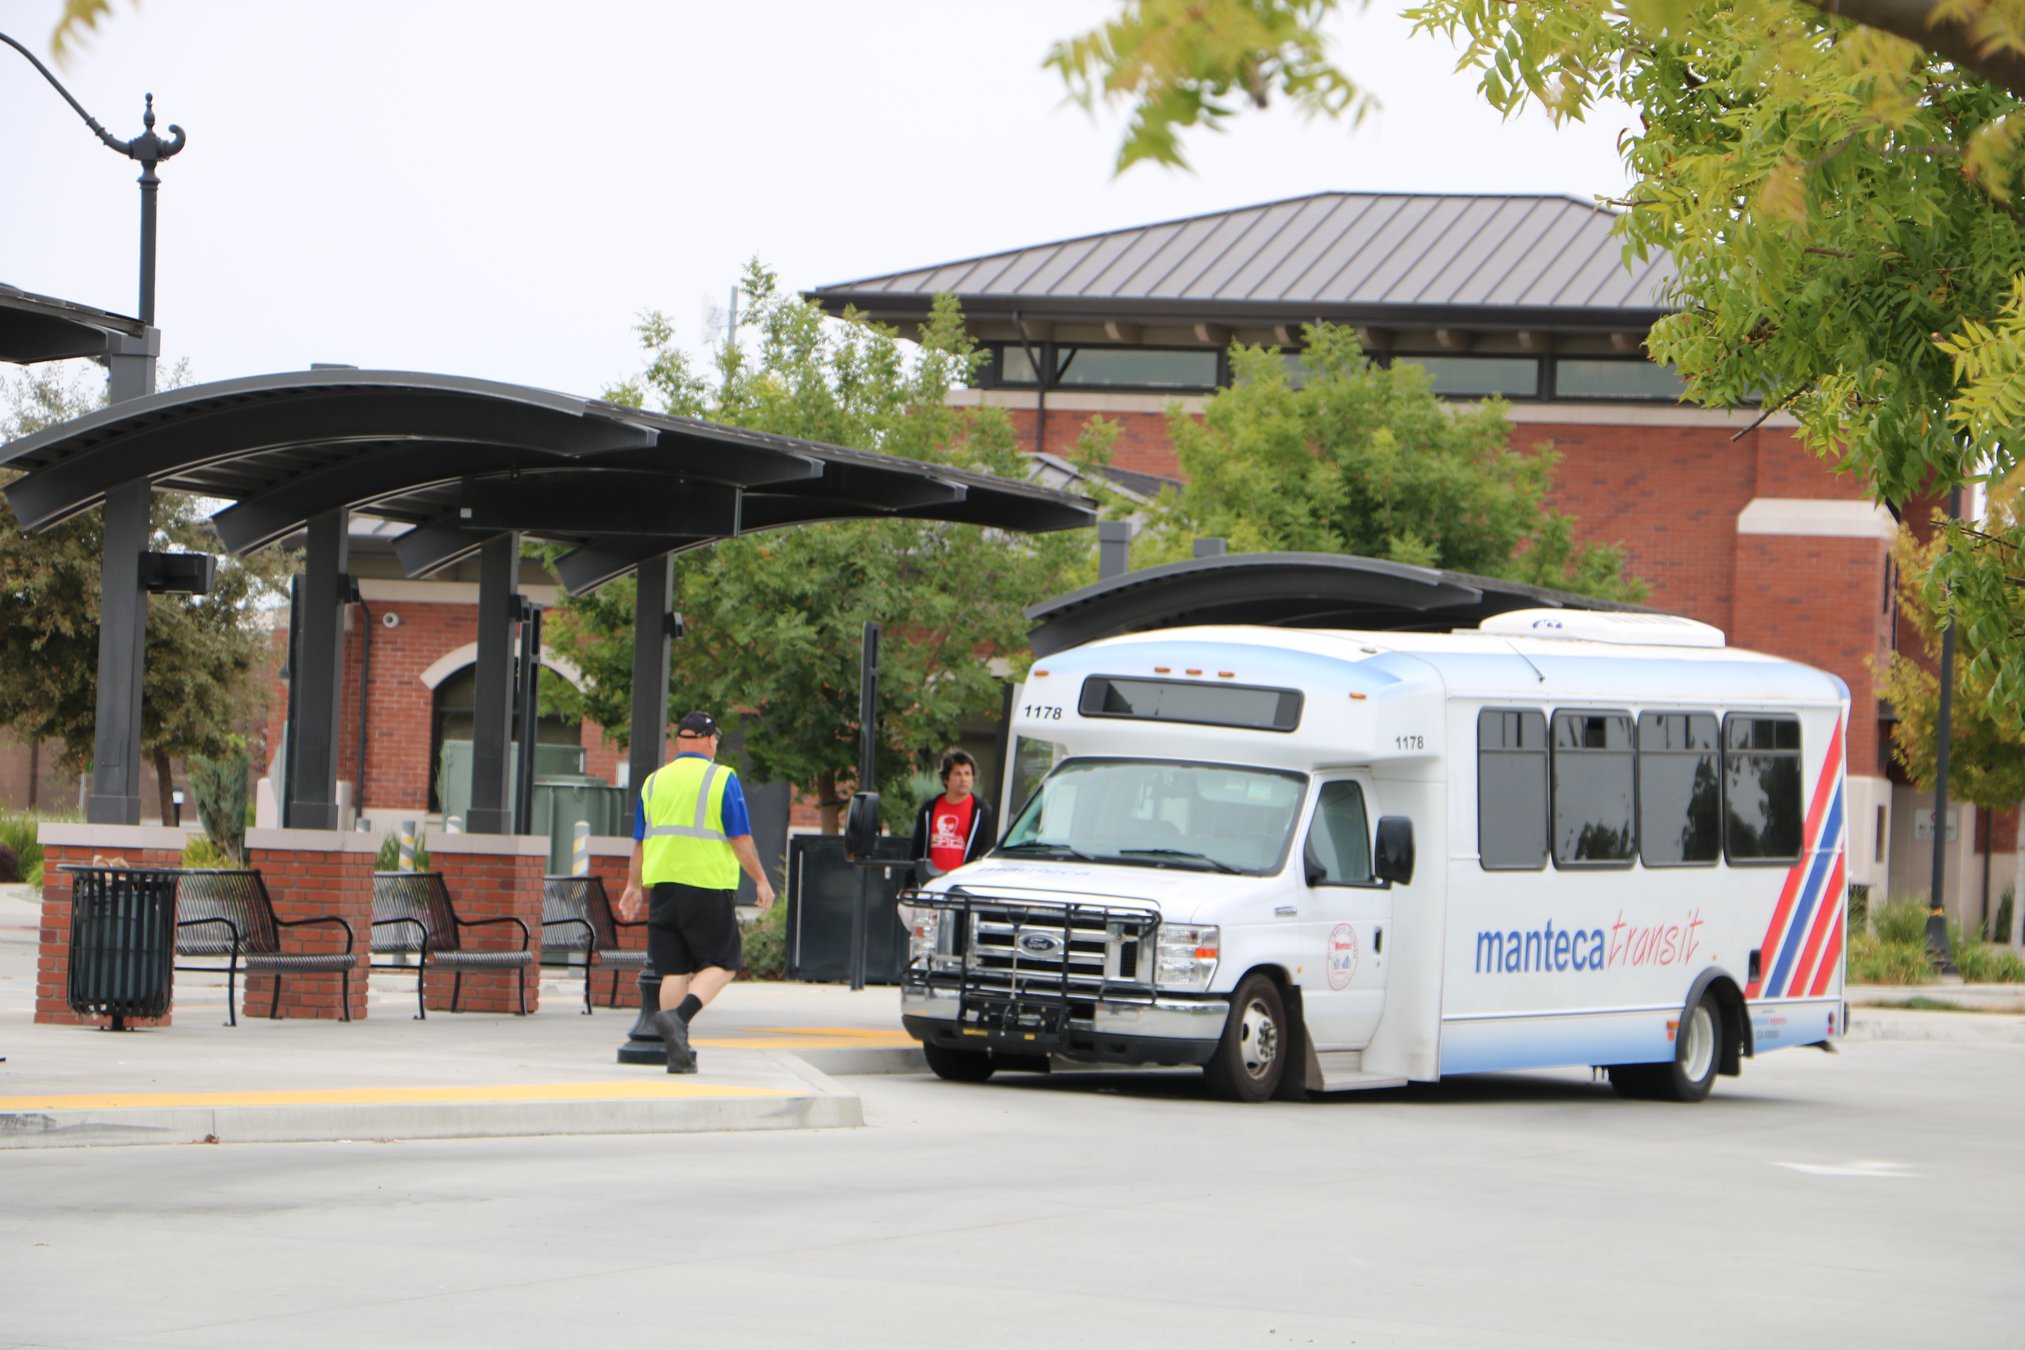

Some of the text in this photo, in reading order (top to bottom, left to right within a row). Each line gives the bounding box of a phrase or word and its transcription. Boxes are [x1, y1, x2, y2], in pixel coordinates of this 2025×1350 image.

[1025, 704, 1062, 720] 1178
[1395, 735, 1424, 750] 1178
[1475, 907, 1704, 974] manteca transit
